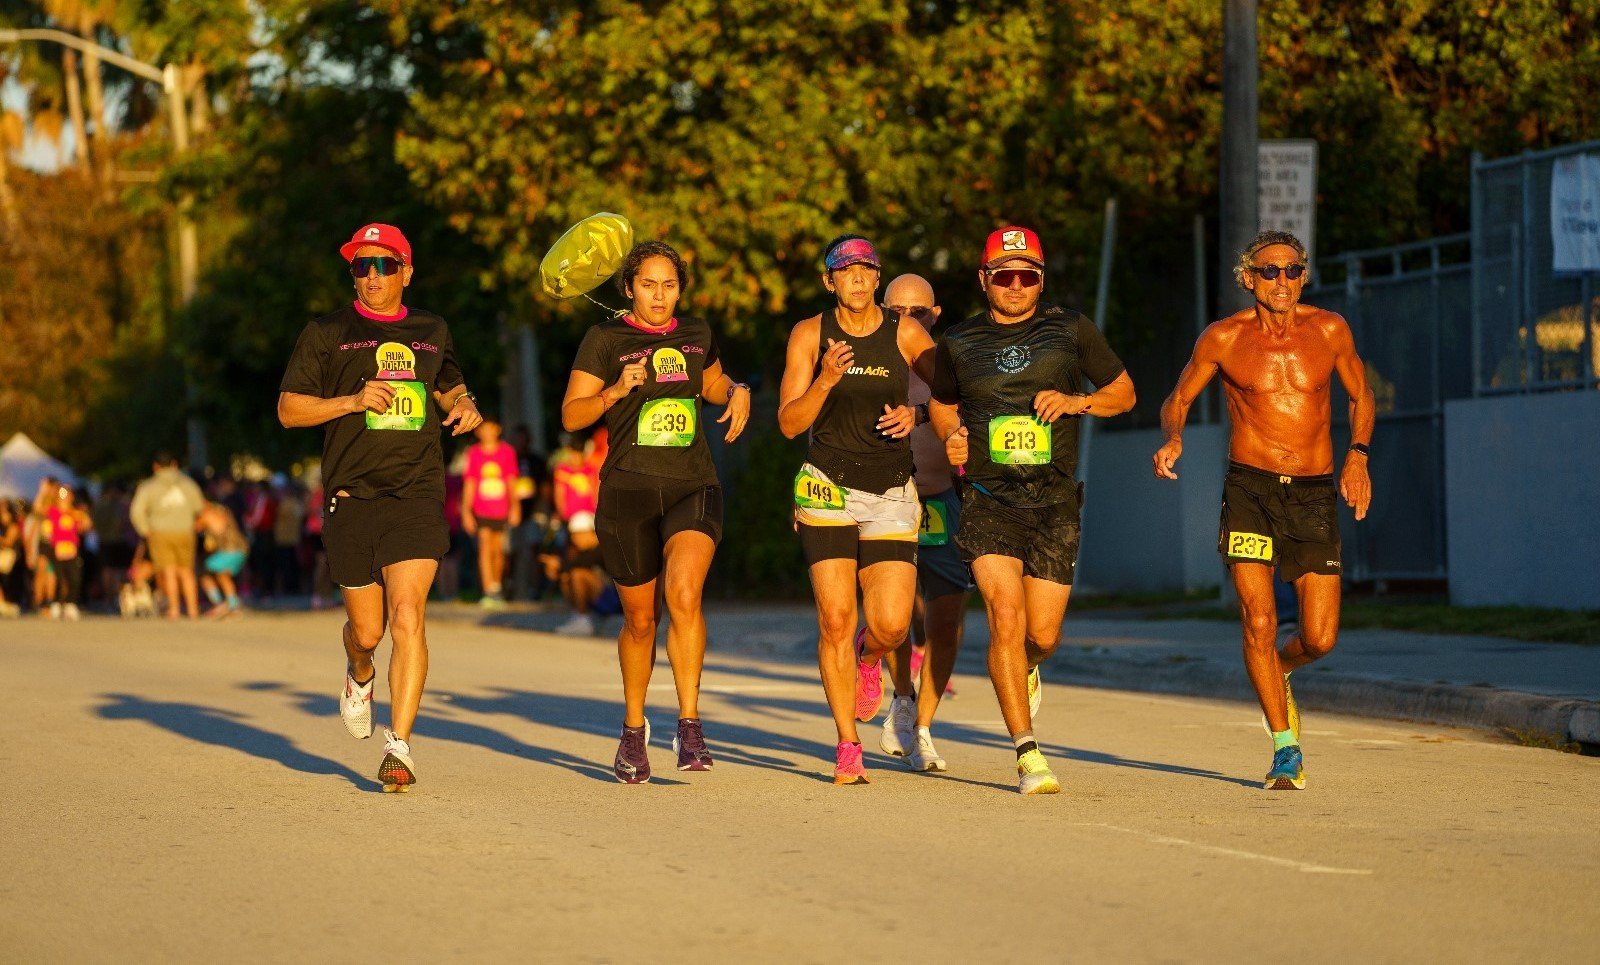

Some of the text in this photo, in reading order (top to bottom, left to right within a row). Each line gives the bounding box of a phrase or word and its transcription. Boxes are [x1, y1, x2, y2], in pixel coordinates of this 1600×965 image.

[385, 351, 404, 361] RUN
[660, 356, 677, 365] RUN
[381, 360, 412, 370] DORAL
[657, 363, 685, 375] DORAL
[844, 365, 890, 378] unAdic
[651, 413, 687, 433] 239
[1004, 431, 1036, 450] 213
[807, 480, 833, 503] 149
[1233, 535, 1268, 557] 237
